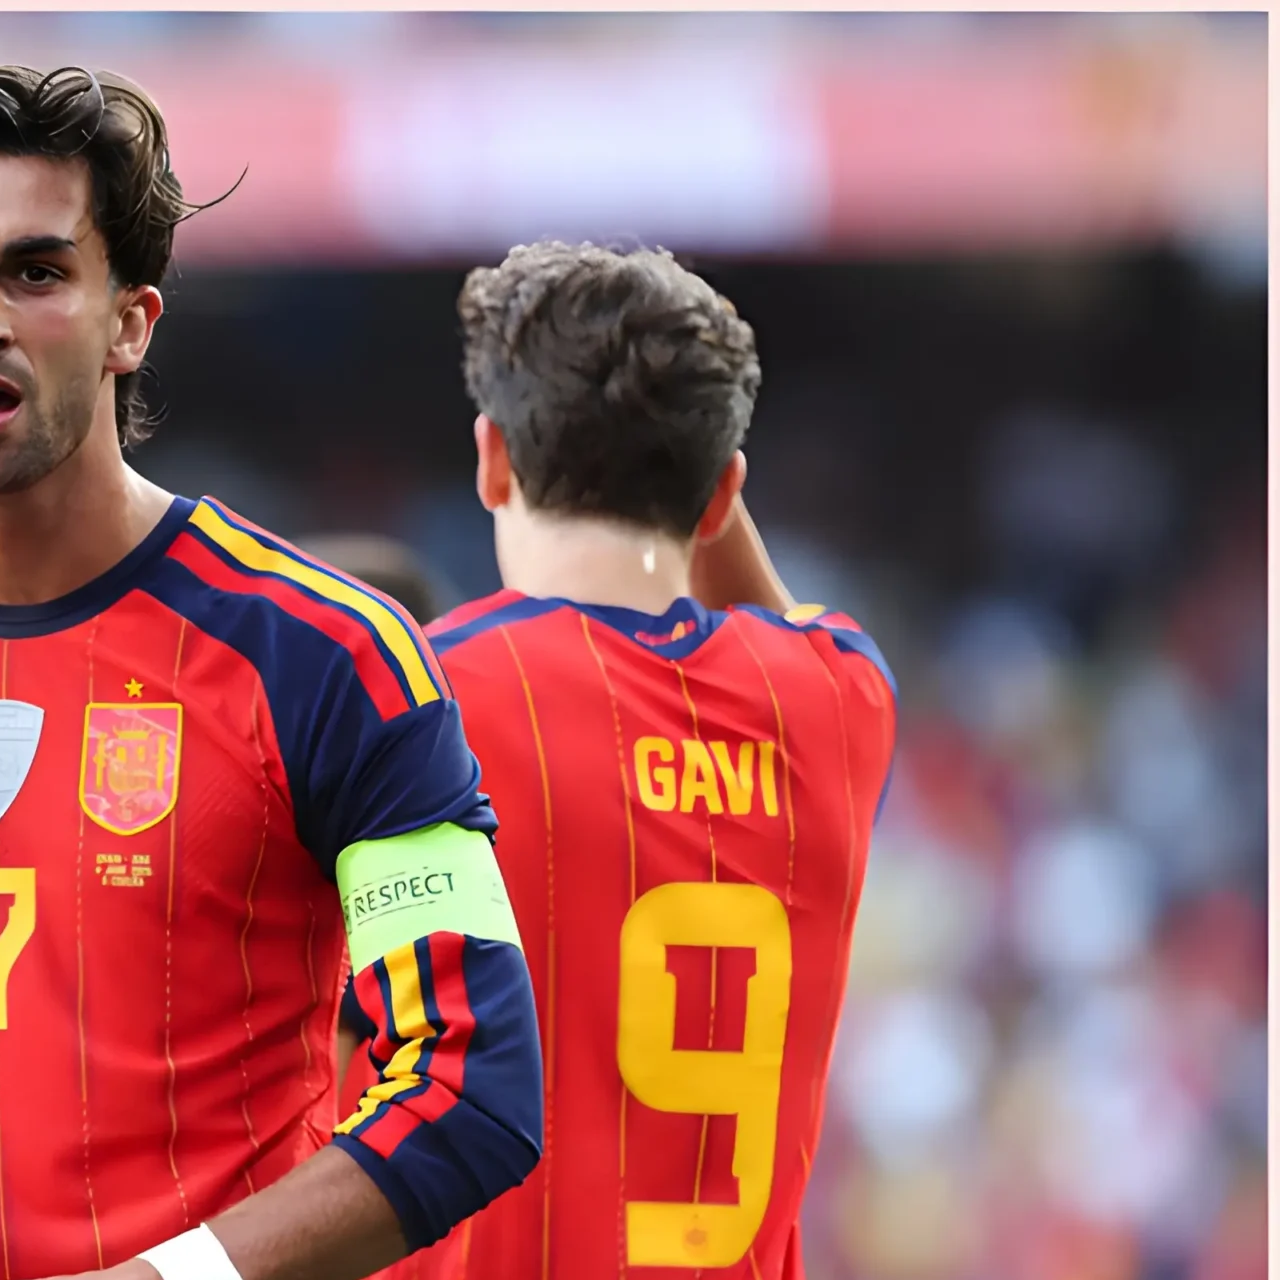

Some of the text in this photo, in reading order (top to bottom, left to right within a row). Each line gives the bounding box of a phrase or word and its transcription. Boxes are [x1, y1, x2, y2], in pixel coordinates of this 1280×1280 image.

[634, 736, 779, 817] GAVI
[354, 872, 454, 918] RESPECT
[617, 881, 793, 1268] 9
